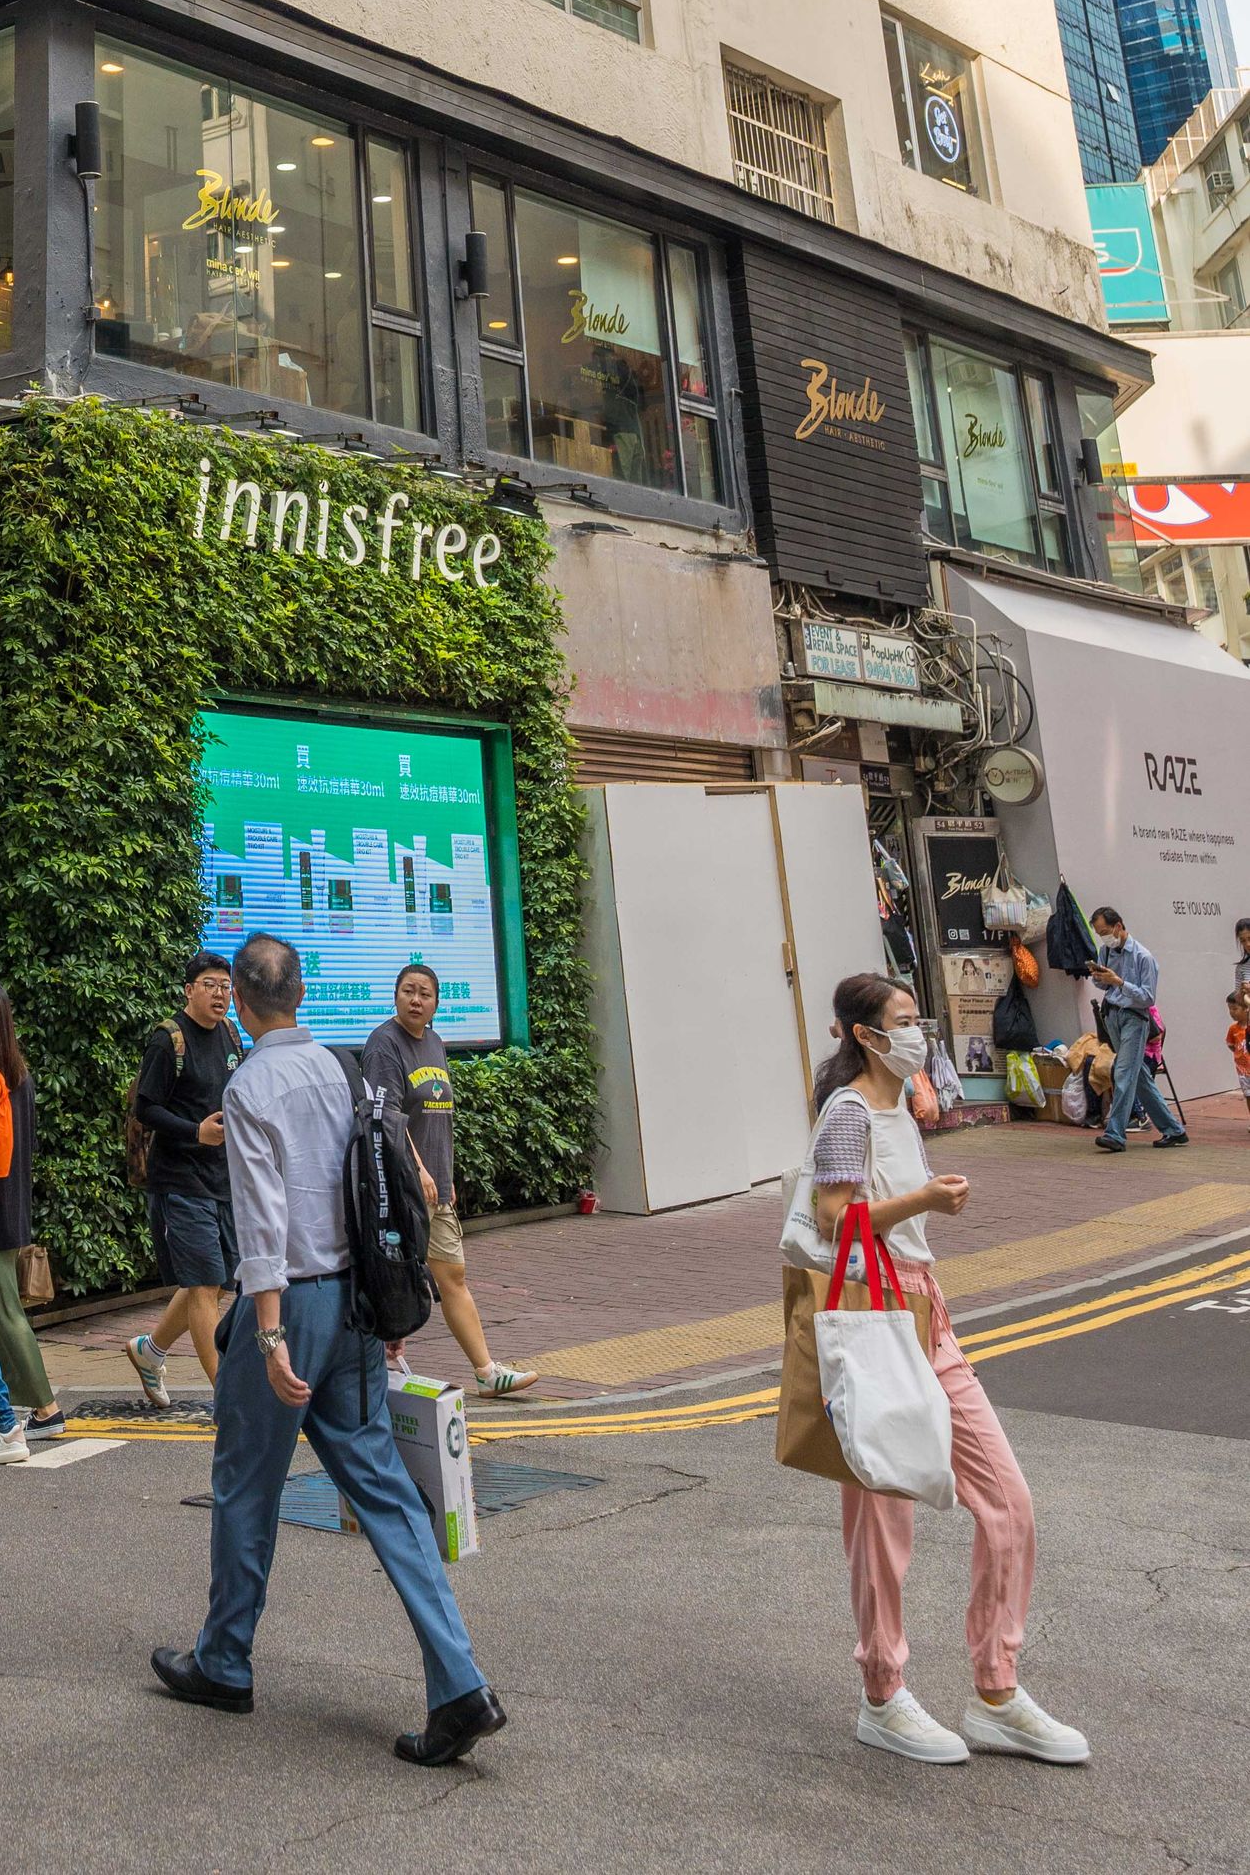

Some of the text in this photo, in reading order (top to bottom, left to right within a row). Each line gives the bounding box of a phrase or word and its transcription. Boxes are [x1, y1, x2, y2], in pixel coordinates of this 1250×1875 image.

[182, 169, 280, 230] Blonde
[213, 222, 277, 249] HAIR AESTHETIC
[560, 289, 630, 344] Blonde
[795, 358, 886, 440] Blonde
[824, 424, 886, 451] HAIR AESTHETIC
[963, 413, 1007, 458] Blonde
[191, 456, 504, 590] innisfree
[811, 625, 833, 640] EVENT
[812, 638, 858, 658] RETAIL SPACE
[811, 654, 857, 678] FOR LEASE
[296, 744, 311, 770] 買
[398, 754, 411, 779] 買
[1143, 752, 1203, 796] RAZE
[1132, 824, 1235, 848] A brand new RAZE where happiness
[1159, 850, 1218, 865] radiates from within
[941, 872, 992, 900] Blonde
[1172, 901, 1222, 916] SEE YOU SOON
[372, 1131, 389, 1219] SUPREME
